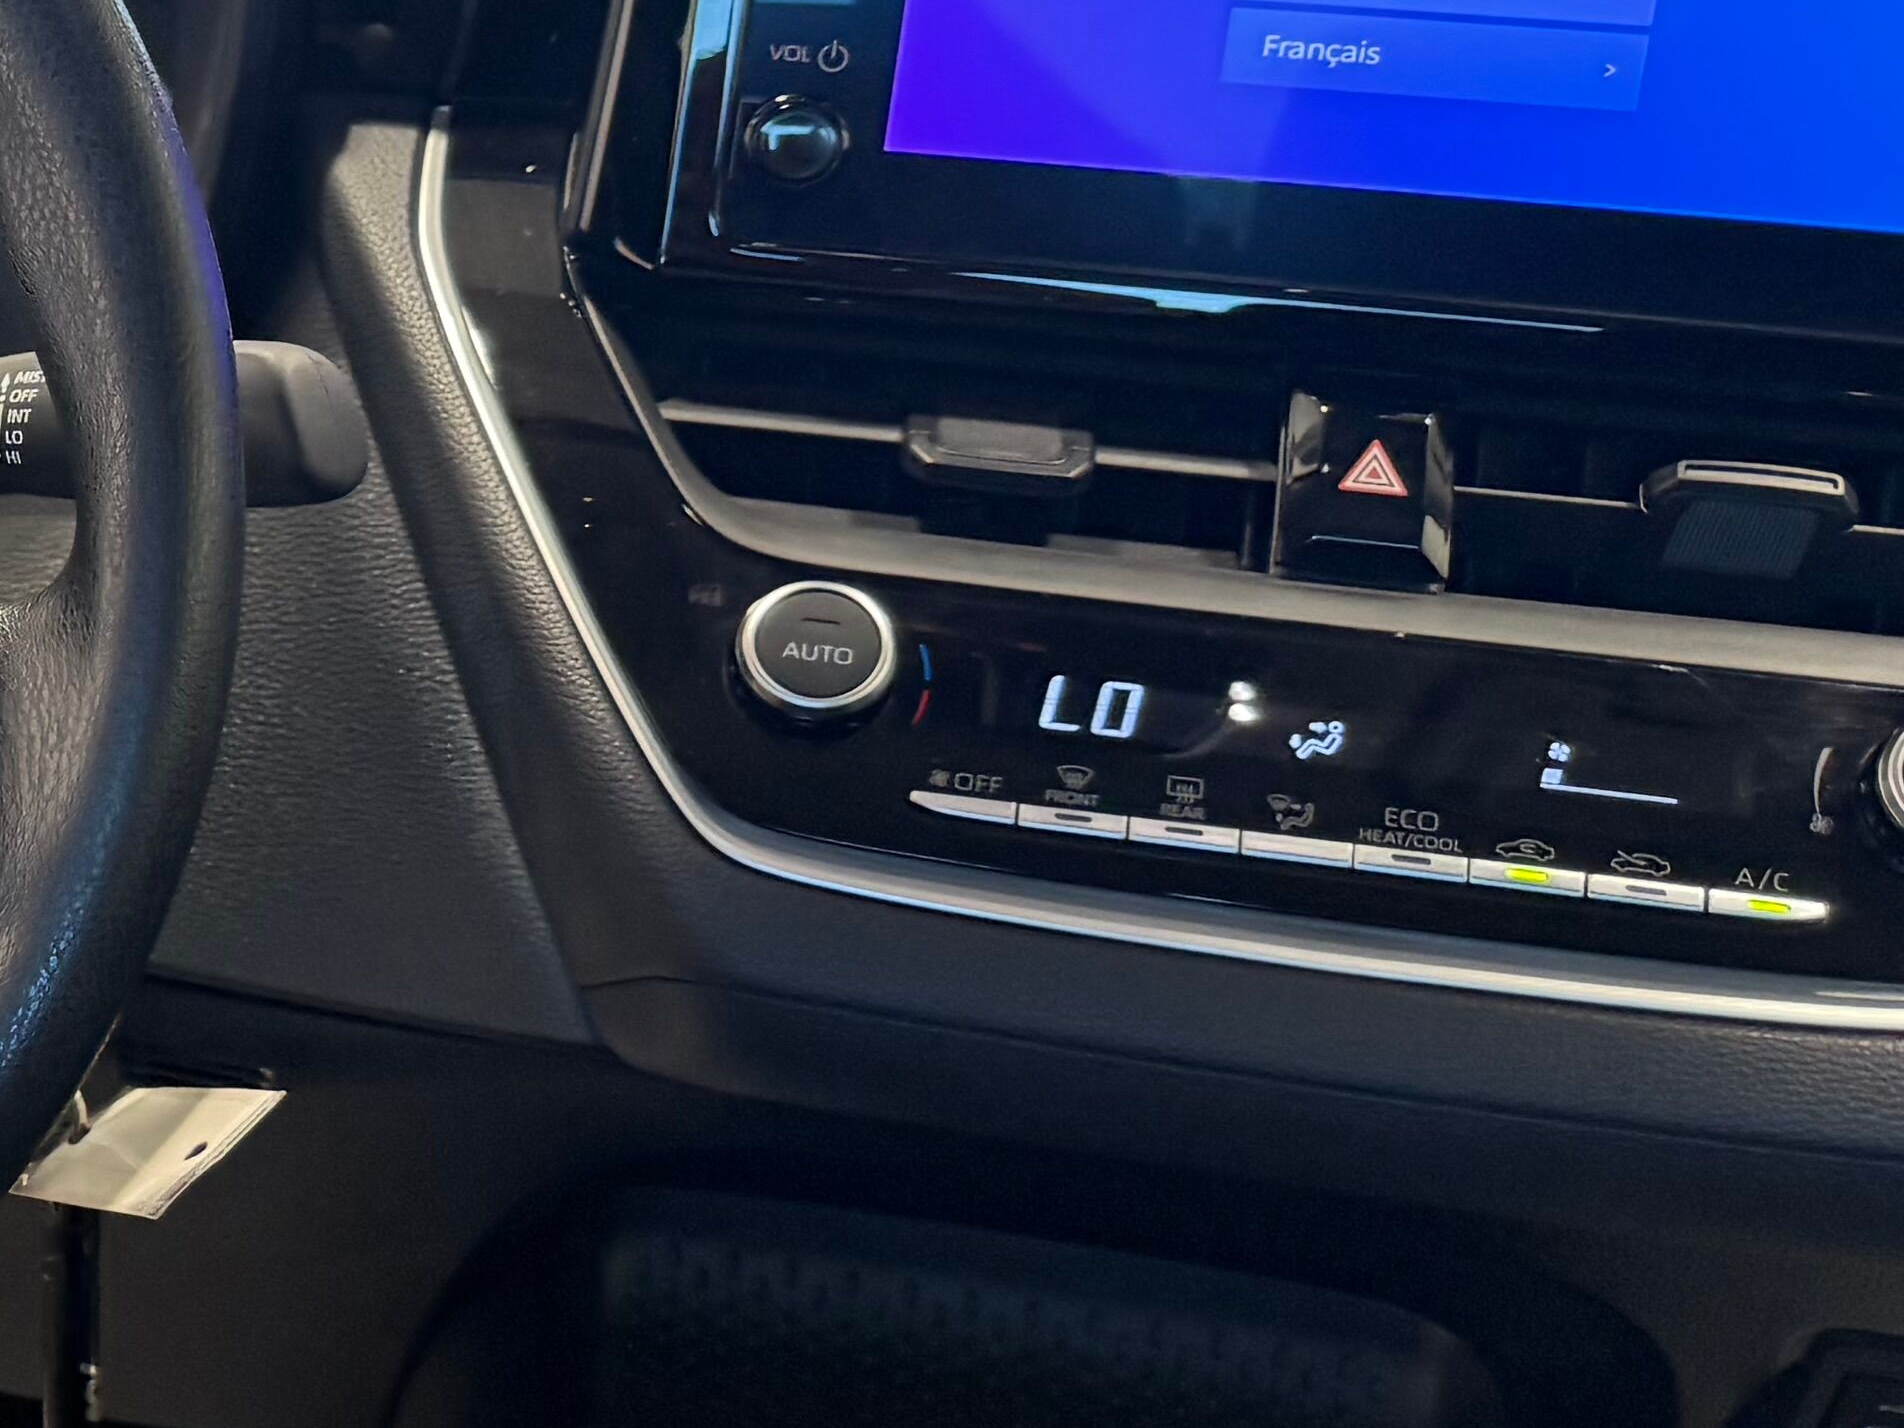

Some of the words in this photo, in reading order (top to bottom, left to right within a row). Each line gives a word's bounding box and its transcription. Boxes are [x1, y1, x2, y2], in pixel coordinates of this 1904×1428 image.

[770, 44, 811, 64] VOL
[1262, 35, 1381, 68] Français
[9, 389, 39, 403] OFF
[7, 409, 32, 424] INT
[5, 430, 24, 444] LO
[5, 451, 22, 465] HI
[782, 641, 853, 666] AUTO
[1038, 674, 1144, 739] LO
[953, 772, 1003, 794] OFF
[1045, 789, 1100, 807] FRONT
[1160, 802, 1207, 820] REAR
[1384, 807, 1440, 833] ECO
[1358, 827, 1463, 854] HEAT/COOL
[1734, 867, 1790, 892] A/C
